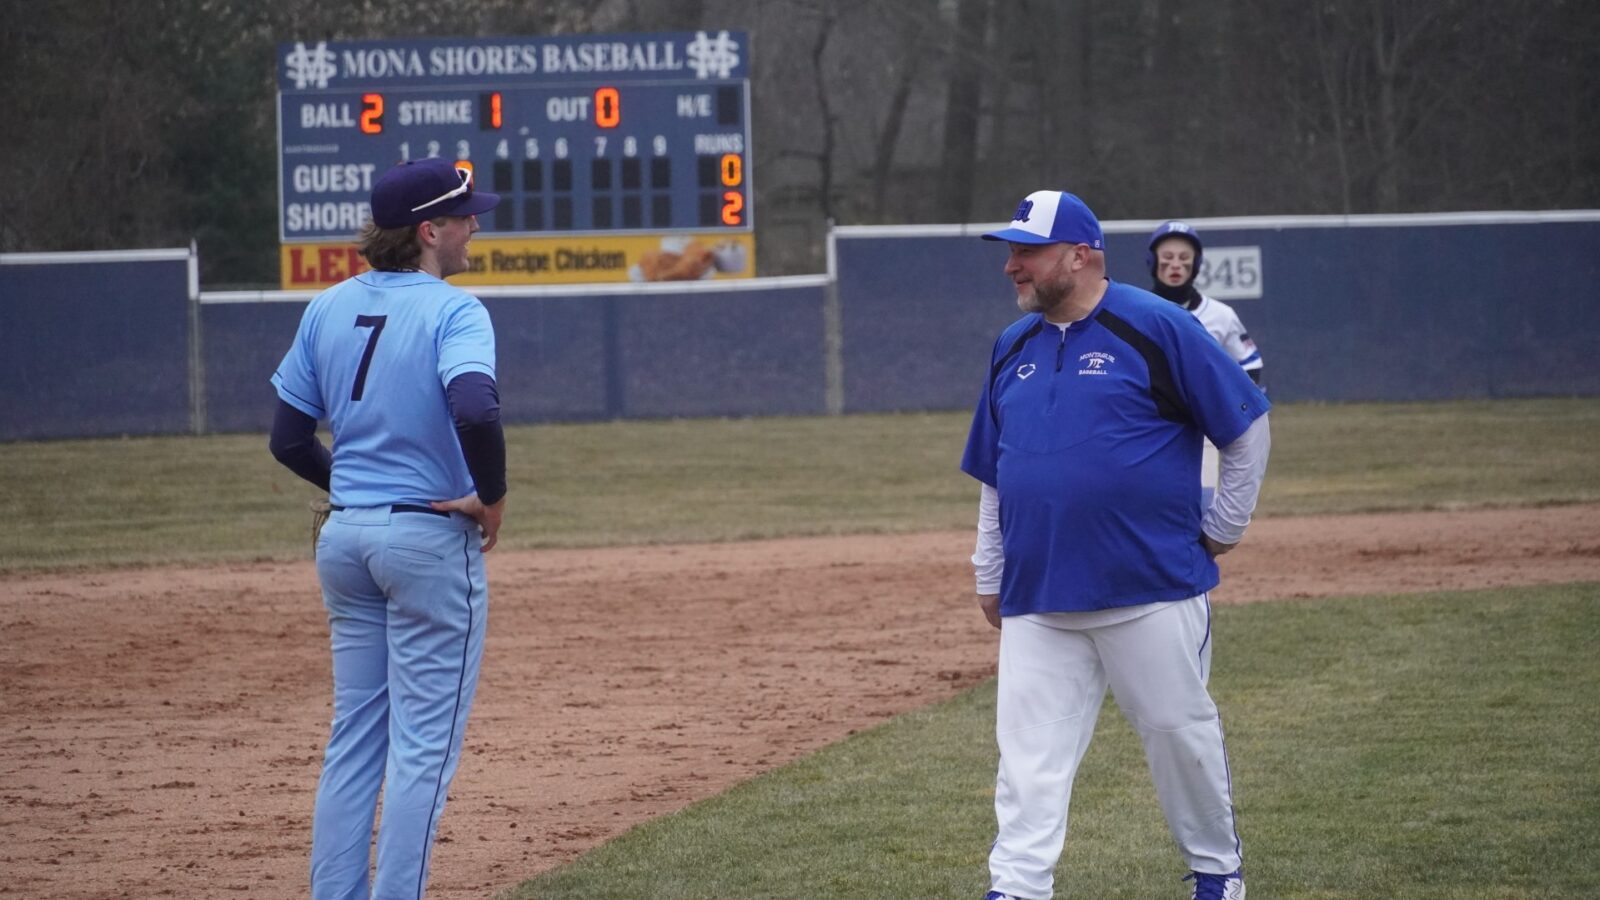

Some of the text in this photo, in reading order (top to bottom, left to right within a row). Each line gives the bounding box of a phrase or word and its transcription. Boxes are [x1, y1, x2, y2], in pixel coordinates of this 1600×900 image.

[342, 50, 424, 77] MONA
[429, 45, 537, 76] SHORES
[542, 41, 683, 72] BASEBALL
[301, 103, 356, 128] BALL
[360, 93, 384, 134] 2
[398, 100, 472, 125] STRIKE
[490, 92, 503, 129] 1
[546, 96, 590, 122] OUT
[594, 87, 620, 128] 0
[676, 94, 712, 118] H/E
[400, 134, 667, 161] 1 2 3 4 5 6 7 8 9
[694, 133, 744, 155] RUNS
[293, 164, 375, 193] GUEST
[720, 153, 743, 187] 0
[721, 191, 744, 226] 2
[491, 249, 550, 275] Recipe
[555, 247, 626, 271] Chicken
[350, 314, 388, 402] 7
